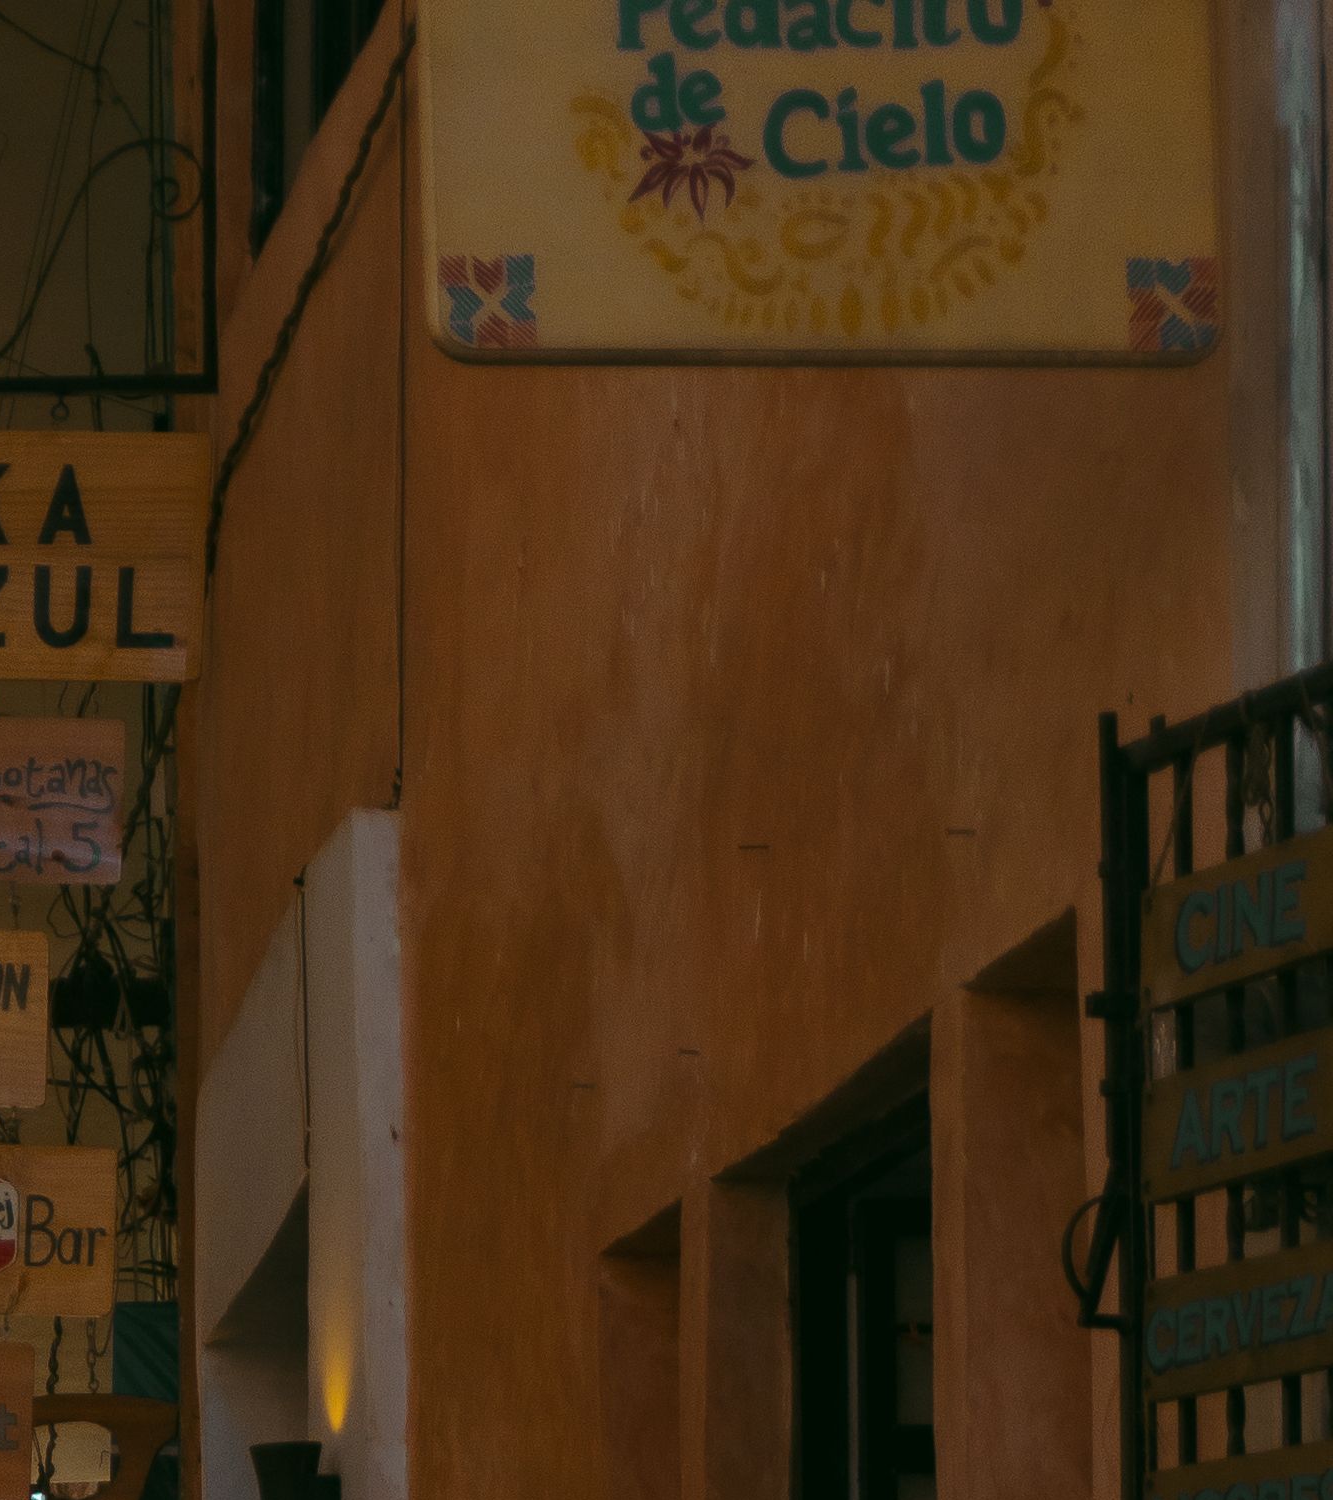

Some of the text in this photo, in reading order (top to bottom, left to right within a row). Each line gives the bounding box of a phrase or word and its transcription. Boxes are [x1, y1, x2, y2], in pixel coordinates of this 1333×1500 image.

[631, 52, 1006, 178] de Cielo
[64, 822, 102, 873] 5
[1175, 860, 1307, 974] CINE
[1170, 1054, 1318, 1170] ARTE
[24, 1194, 107, 1268] Bar
